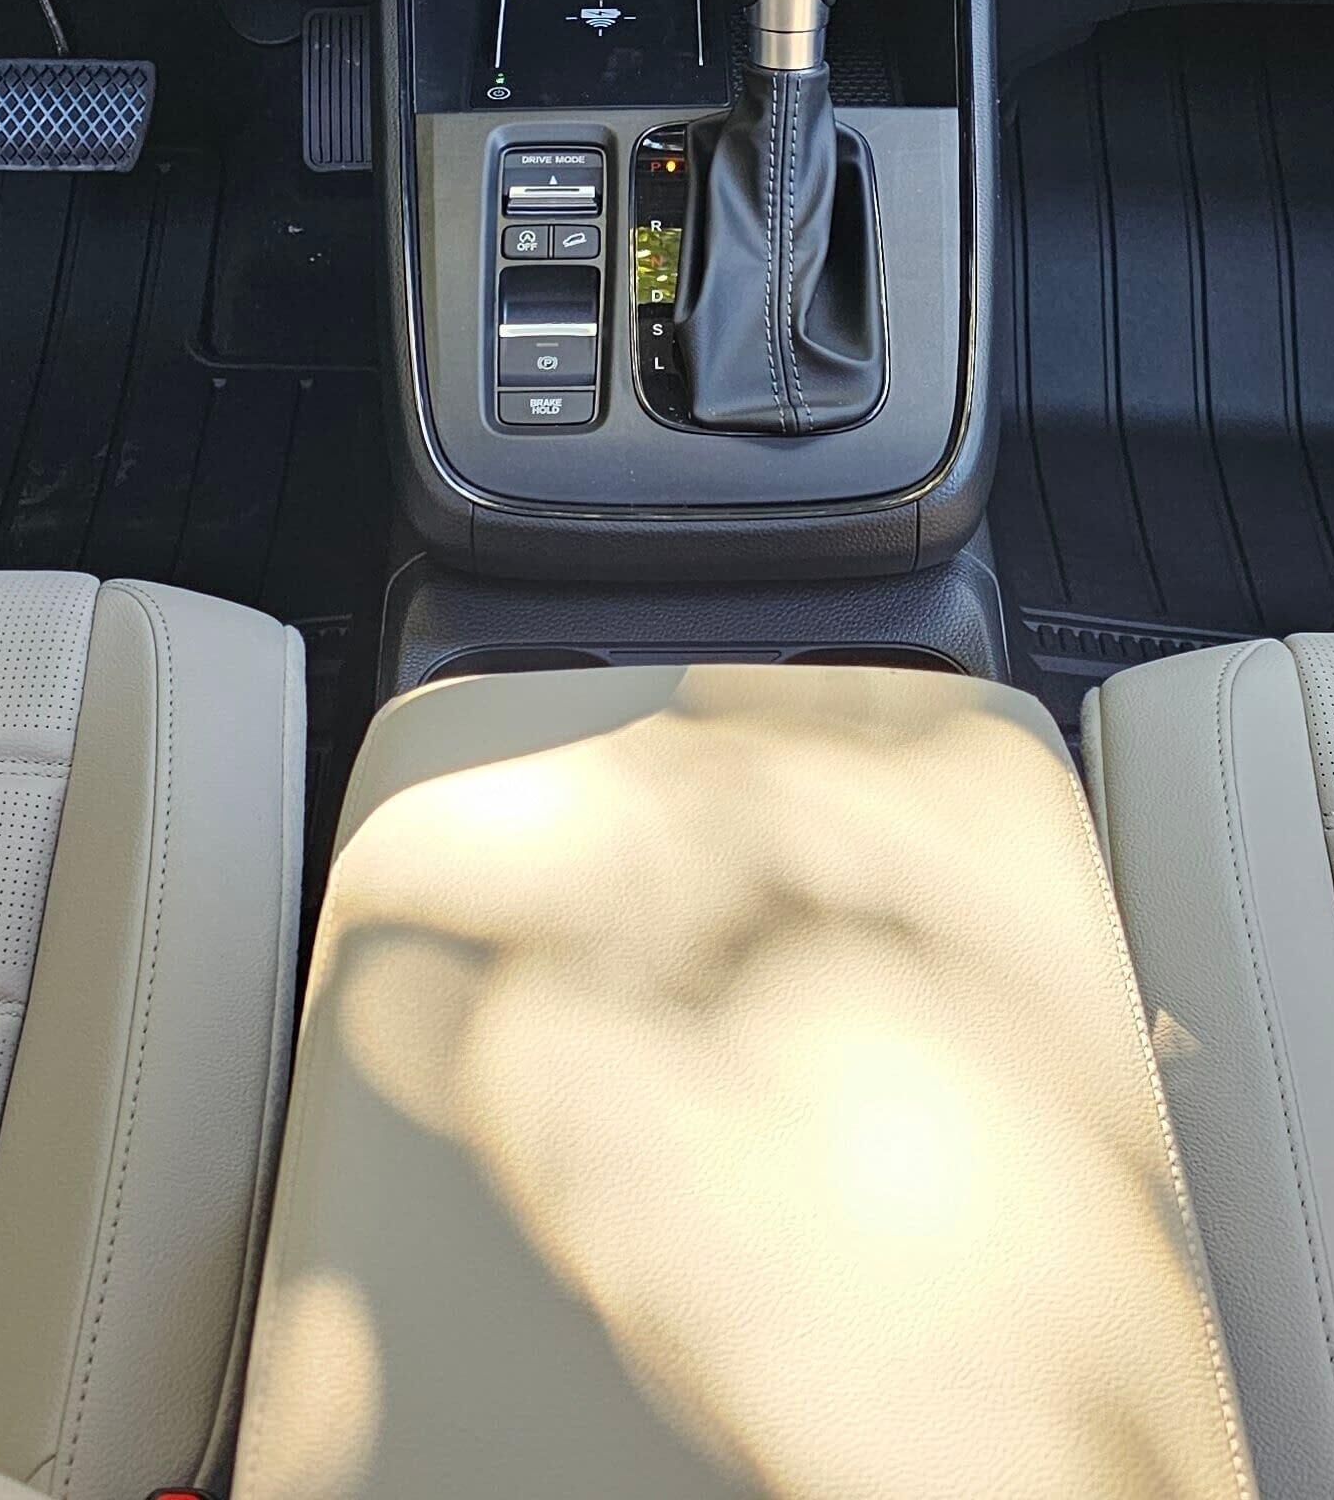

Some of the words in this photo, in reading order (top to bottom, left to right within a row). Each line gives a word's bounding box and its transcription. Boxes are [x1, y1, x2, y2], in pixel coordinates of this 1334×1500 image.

[522, 155, 552, 164] DRIVE
[555, 155, 586, 164] MODE
[651, 162, 662, 172] P
[650, 220, 662, 232] R
[516, 242, 538, 252] OFF
[651, 254, 664, 266] N
[651, 289, 664, 302] D
[652, 323, 664, 336] S
[654, 357, 665, 370] L
[530, 399, 562, 407] BRAKE
[532, 405, 560, 414] HOLD
